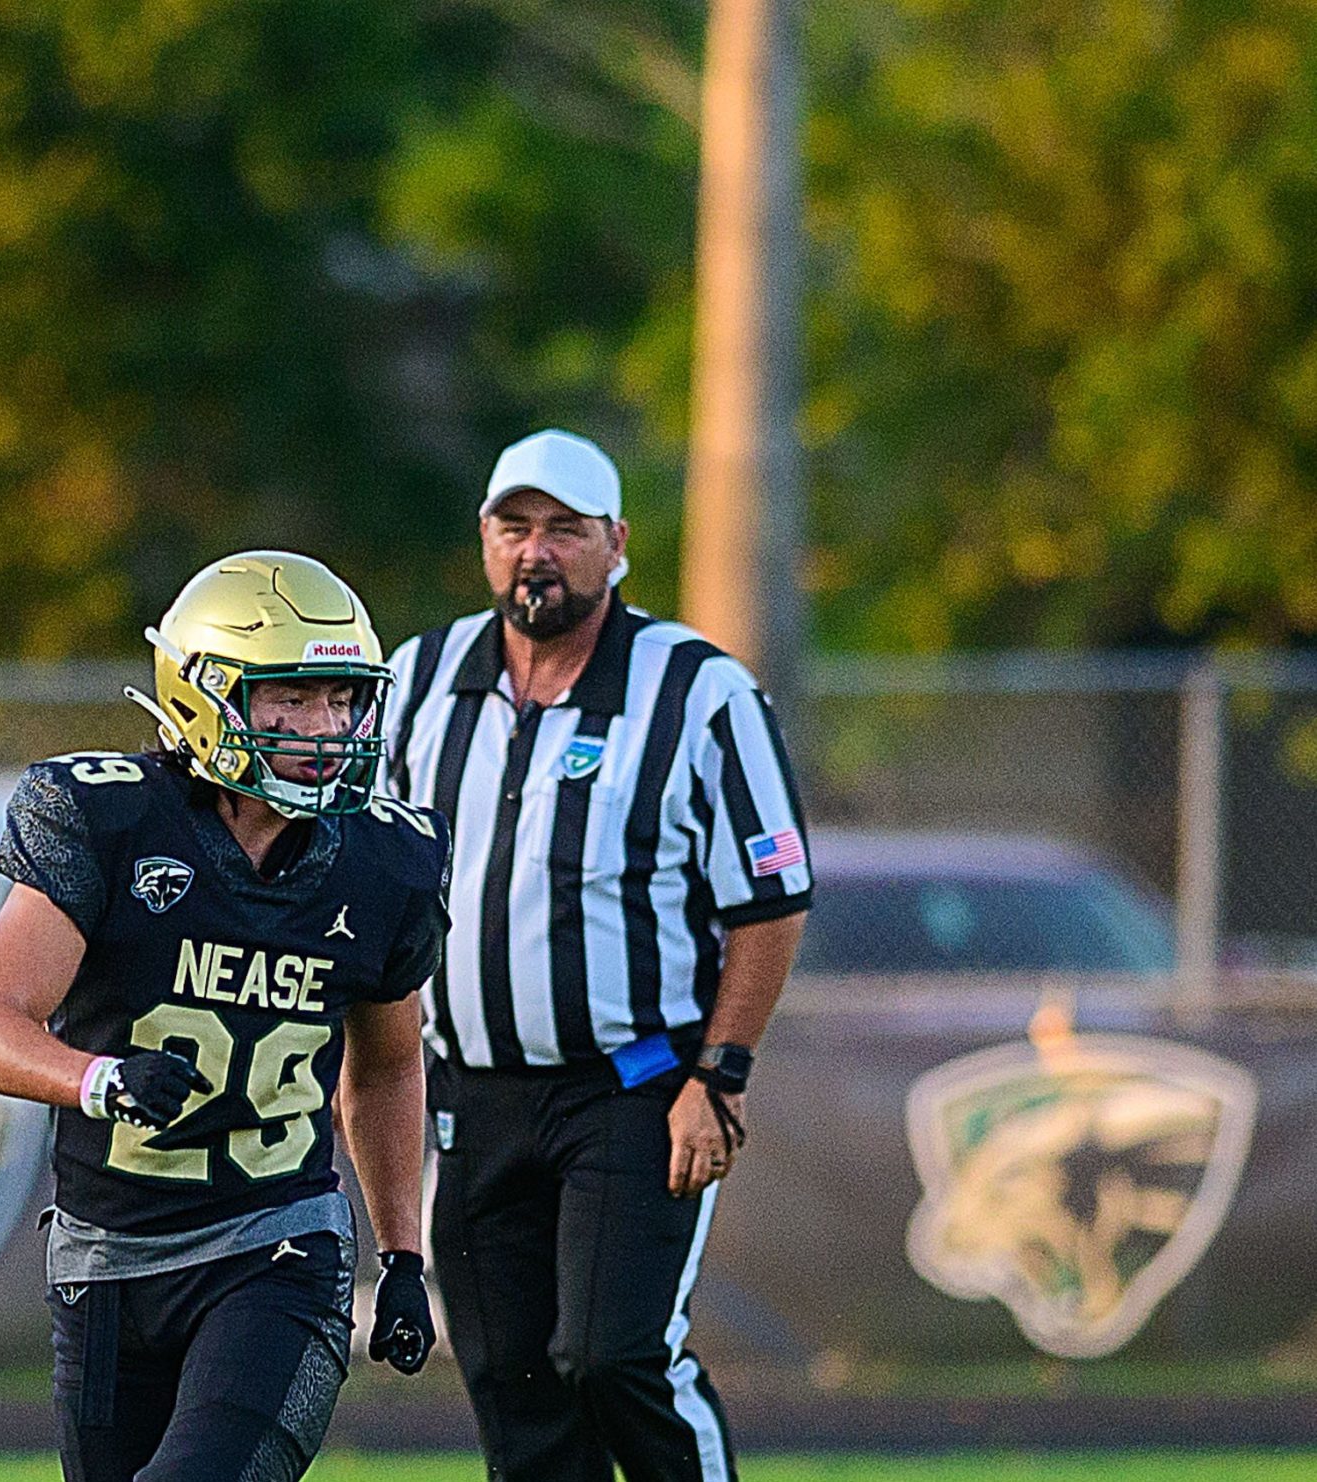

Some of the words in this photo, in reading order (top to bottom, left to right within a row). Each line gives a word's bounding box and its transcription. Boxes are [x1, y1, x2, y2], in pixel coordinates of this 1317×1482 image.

[313, 643, 361, 657] Riddell
[173, 938, 335, 1012] NEASE
[104, 1002, 333, 1184] 29
